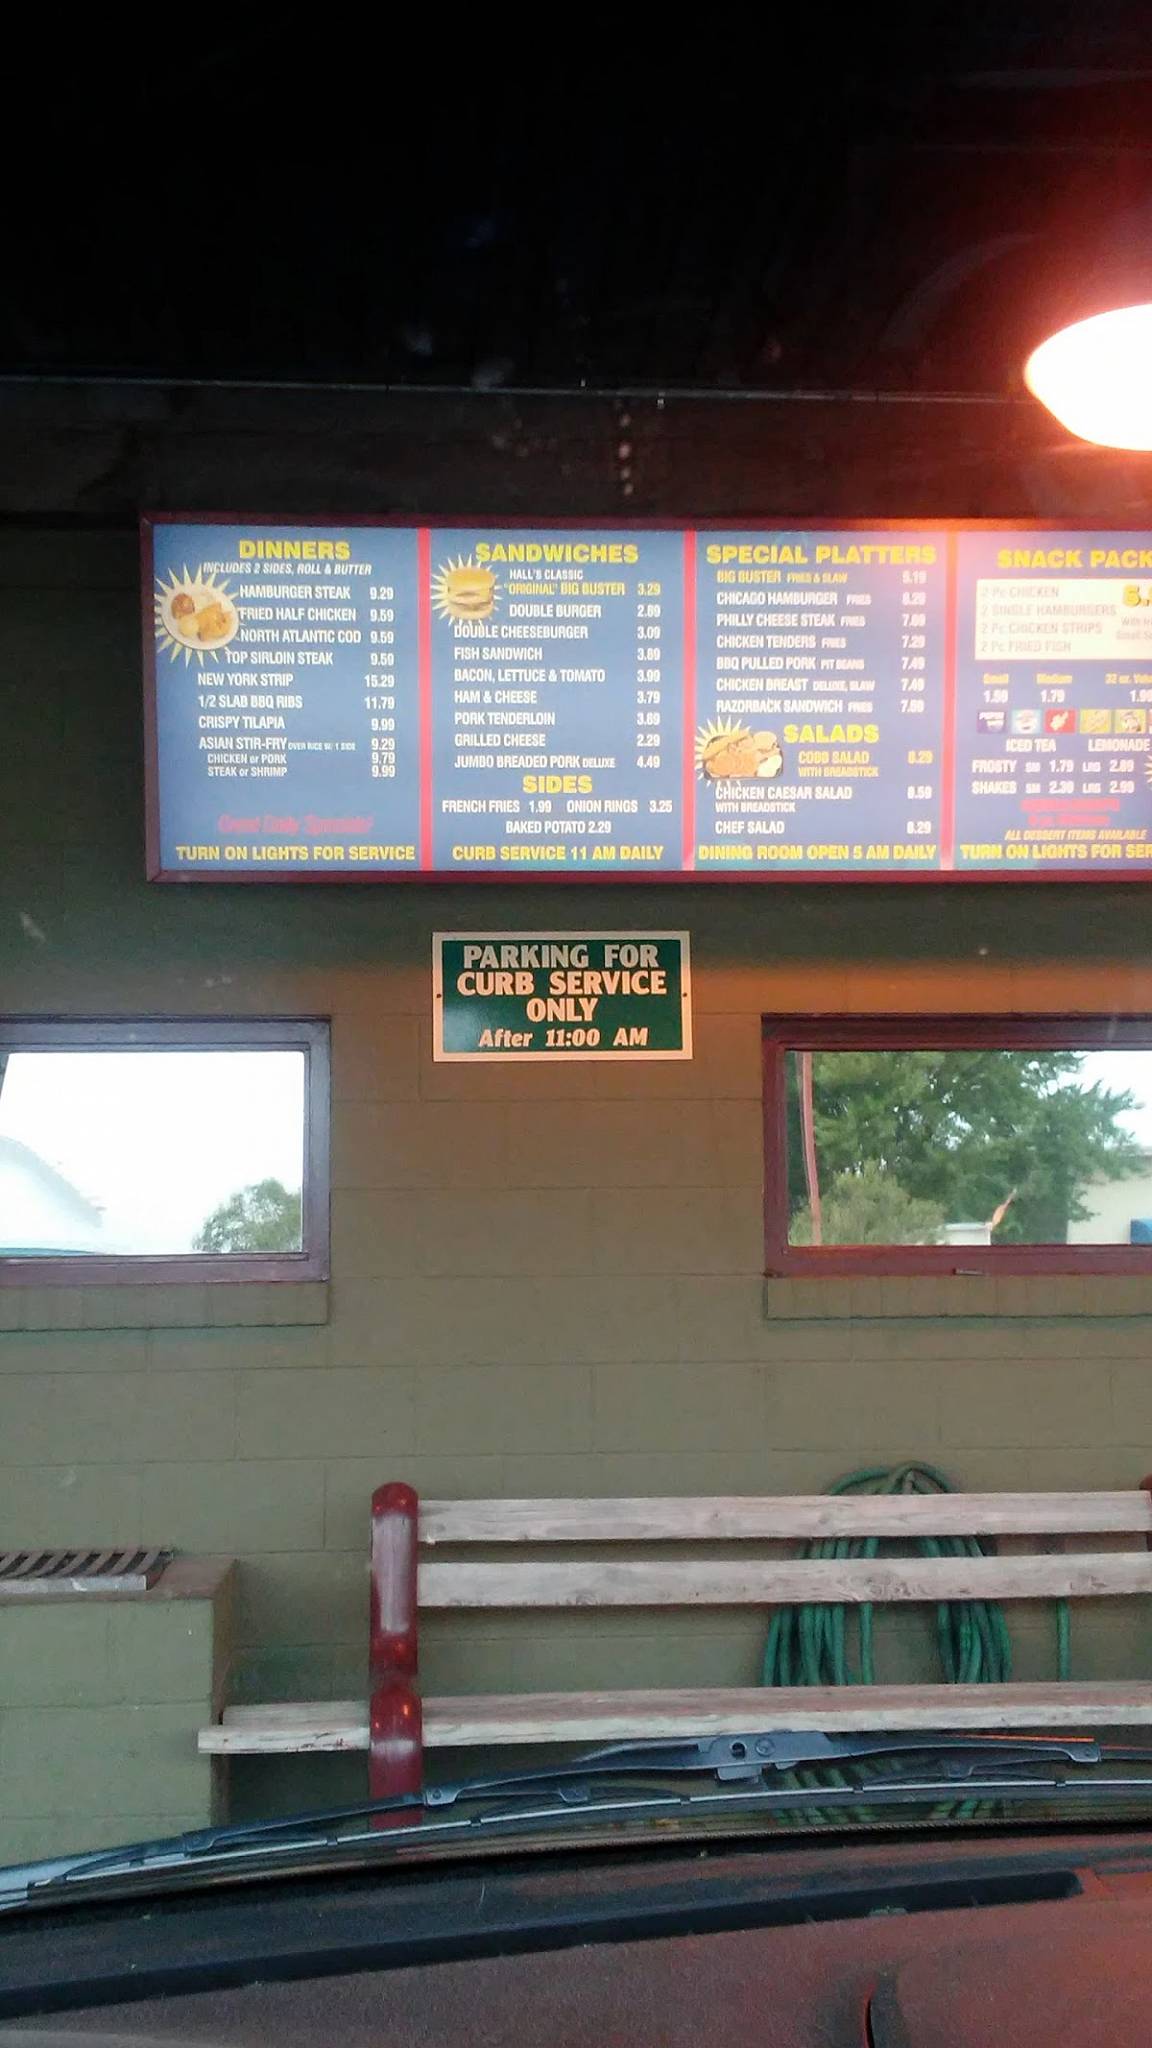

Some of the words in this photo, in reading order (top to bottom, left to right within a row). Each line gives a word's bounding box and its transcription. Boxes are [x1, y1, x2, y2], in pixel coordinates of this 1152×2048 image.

[240, 541, 351, 559] DINNERS
[476, 543, 638, 563] SANDWICHES
[707, 545, 808, 564] SPECIAL
[816, 545, 936, 564] PLATTERS
[998, 549, 1082, 568] SNACK
[203, 563, 252, 574] INCLUDES
[297, 564, 322, 574] ROLL
[325, 564, 331, 574] &
[334, 564, 372, 576] BUTTER
[545, 570, 583, 580] CLASSIC
[717, 571, 736, 583] BIG
[739, 571, 781, 583] BUSTER
[240, 585, 313, 599] HAMBURGER
[315, 586, 350, 599] STEAK
[370, 587, 393, 600] 9.29
[560, 583, 579, 595] BIG
[582, 583, 625, 595] BUSTER
[638, 583, 660, 595] 3.29
[717, 592, 766, 605] CHICAGO
[768, 592, 837, 605] HAMBURGER
[240, 607, 273, 620] FRIED
[276, 608, 304, 620] HALF
[308, 608, 356, 621] CHICKEN
[370, 609, 393, 621] 9.59
[510, 605, 553, 617] DOUBLE
[556, 605, 601, 617] BURGER
[717, 614, 753, 626] PHILLY
[757, 614, 798, 626] CHEESE
[801, 614, 835, 626] STEAK
[241, 629, 279, 642] NORTH
[283, 630, 335, 643] ATLANTIC
[338, 630, 361, 643] COD
[370, 631, 393, 643] 9.59
[455, 626, 498, 638] DOUBLE
[501, 626, 588, 638] CHEESEBURGER
[717, 635, 763, 648] CHICKEN
[766, 635, 816, 648] TENDERS
[226, 652, 248, 663] TOP
[251, 652, 295, 664] SIRLOIN
[298, 653, 333, 665] STEAK
[370, 653, 394, 665] 9.59
[455, 648, 480, 659] FISH
[482, 648, 542, 659] SANDWICH
[717, 657, 738, 669] BBQ
[742, 657, 783, 669] PULLED
[786, 657, 816, 669] PORK
[198, 673, 224, 685] NEW
[227, 673, 257, 685] YORK
[260, 674, 293, 685] STRIP
[364, 675, 394, 687] 15.29
[455, 669, 495, 683] BACON,
[498, 669, 546, 681] LETTUCE
[549, 669, 557, 681] &
[560, 669, 605, 682] TOMATO
[716, 679, 763, 691] CHICKEN
[766, 679, 808, 691] BREAST
[199, 696, 216, 707] 1/2
[219, 696, 248, 707] SLAB
[250, 696, 274, 709] BBQ
[277, 696, 302, 708] RIBS
[364, 697, 395, 709] 11.79
[455, 691, 481, 704] HAM
[483, 691, 492, 704] &
[495, 691, 537, 704] CHEESE
[637, 691, 660, 704] 3.79
[717, 700, 781, 712] RAZORBACK
[784, 700, 842, 712] SANDWICH
[199, 717, 239, 728] CRISPY
[242, 717, 284, 729] TILAPIA
[371, 719, 395, 731] 9.99
[455, 713, 486, 725] PORK
[488, 713, 555, 725] TENDERLOIN
[455, 734, 500, 746] GRILLED
[504, 734, 545, 746] CHEESE
[637, 734, 660, 746] 2.29
[784, 725, 879, 743] SALADS
[199, 737, 233, 749] ASIAN
[236, 737, 287, 750] STIR-FRY
[372, 738, 395, 750] 9.29
[1035, 739, 1056, 752] TEA
[1089, 739, 1150, 752] LEMONADE
[208, 753, 247, 763] CHICKEN
[262, 754, 287, 764] PORK
[372, 752, 395, 764] 9.79
[455, 756, 494, 768] JUMBO
[497, 756, 547, 768] BREADED
[550, 756, 580, 768] PORK
[582, 759, 615, 768] DELUXE
[637, 756, 660, 768] 4.49
[832, 752, 869, 764] SALAD
[208, 767, 237, 776] STEAK
[239, 769, 248, 777] or
[251, 767, 287, 777] SHRIMP
[372, 765, 395, 777] 9.99
[523, 776, 592, 793] SIDES
[716, 786, 764, 799] CHICKEN
[767, 787, 812, 799] CAESAR
[815, 787, 852, 799] SALAD
[442, 800, 486, 813] FRENCH
[489, 800, 520, 813] FRIES
[529, 800, 551, 813] 1.99
[567, 800, 602, 813] ONION
[604, 800, 638, 813] RINGS
[650, 800, 672, 813] 3.25
[716, 803, 738, 812] WITH
[506, 821, 541, 833] BAKED
[545, 821, 585, 833] POTATO
[588, 821, 611, 833] 2.29
[716, 822, 744, 834] CHEF
[747, 822, 784, 834] SALAD
[176, 846, 220, 860] TURN
[225, 846, 247, 860] ON
[253, 846, 308, 860] LIGHTS
[314, 846, 344, 860] FOR
[349, 846, 415, 860] SERVICE
[453, 847, 496, 860] CURB
[500, 847, 566, 860] SERVICE
[571, 847, 586, 860] 11
[592, 847, 615, 860] AM
[620, 847, 664, 860] DAILY
[699, 846, 752, 859] DINING
[757, 846, 802, 859] ROOM
[807, 846, 849, 859] OPEN
[866, 846, 889, 859] AM
[893, 846, 936, 859] DAILY
[960, 845, 1001, 859] TURN
[1006, 845, 1028, 859] ON
[1033, 845, 1087, 859] LIGHTS
[1091, 845, 1121, 859] FOR
[464, 945, 588, 969] PARKING
[605, 945, 658, 968] FOR
[457, 972, 534, 995] CURB
[550, 971, 667, 995] SERVICE
[527, 998, 598, 1022] ONLY
[479, 1029, 533, 1047] After
[546, 1029, 600, 1046] 11:00
[613, 1028, 648, 1046] AM
